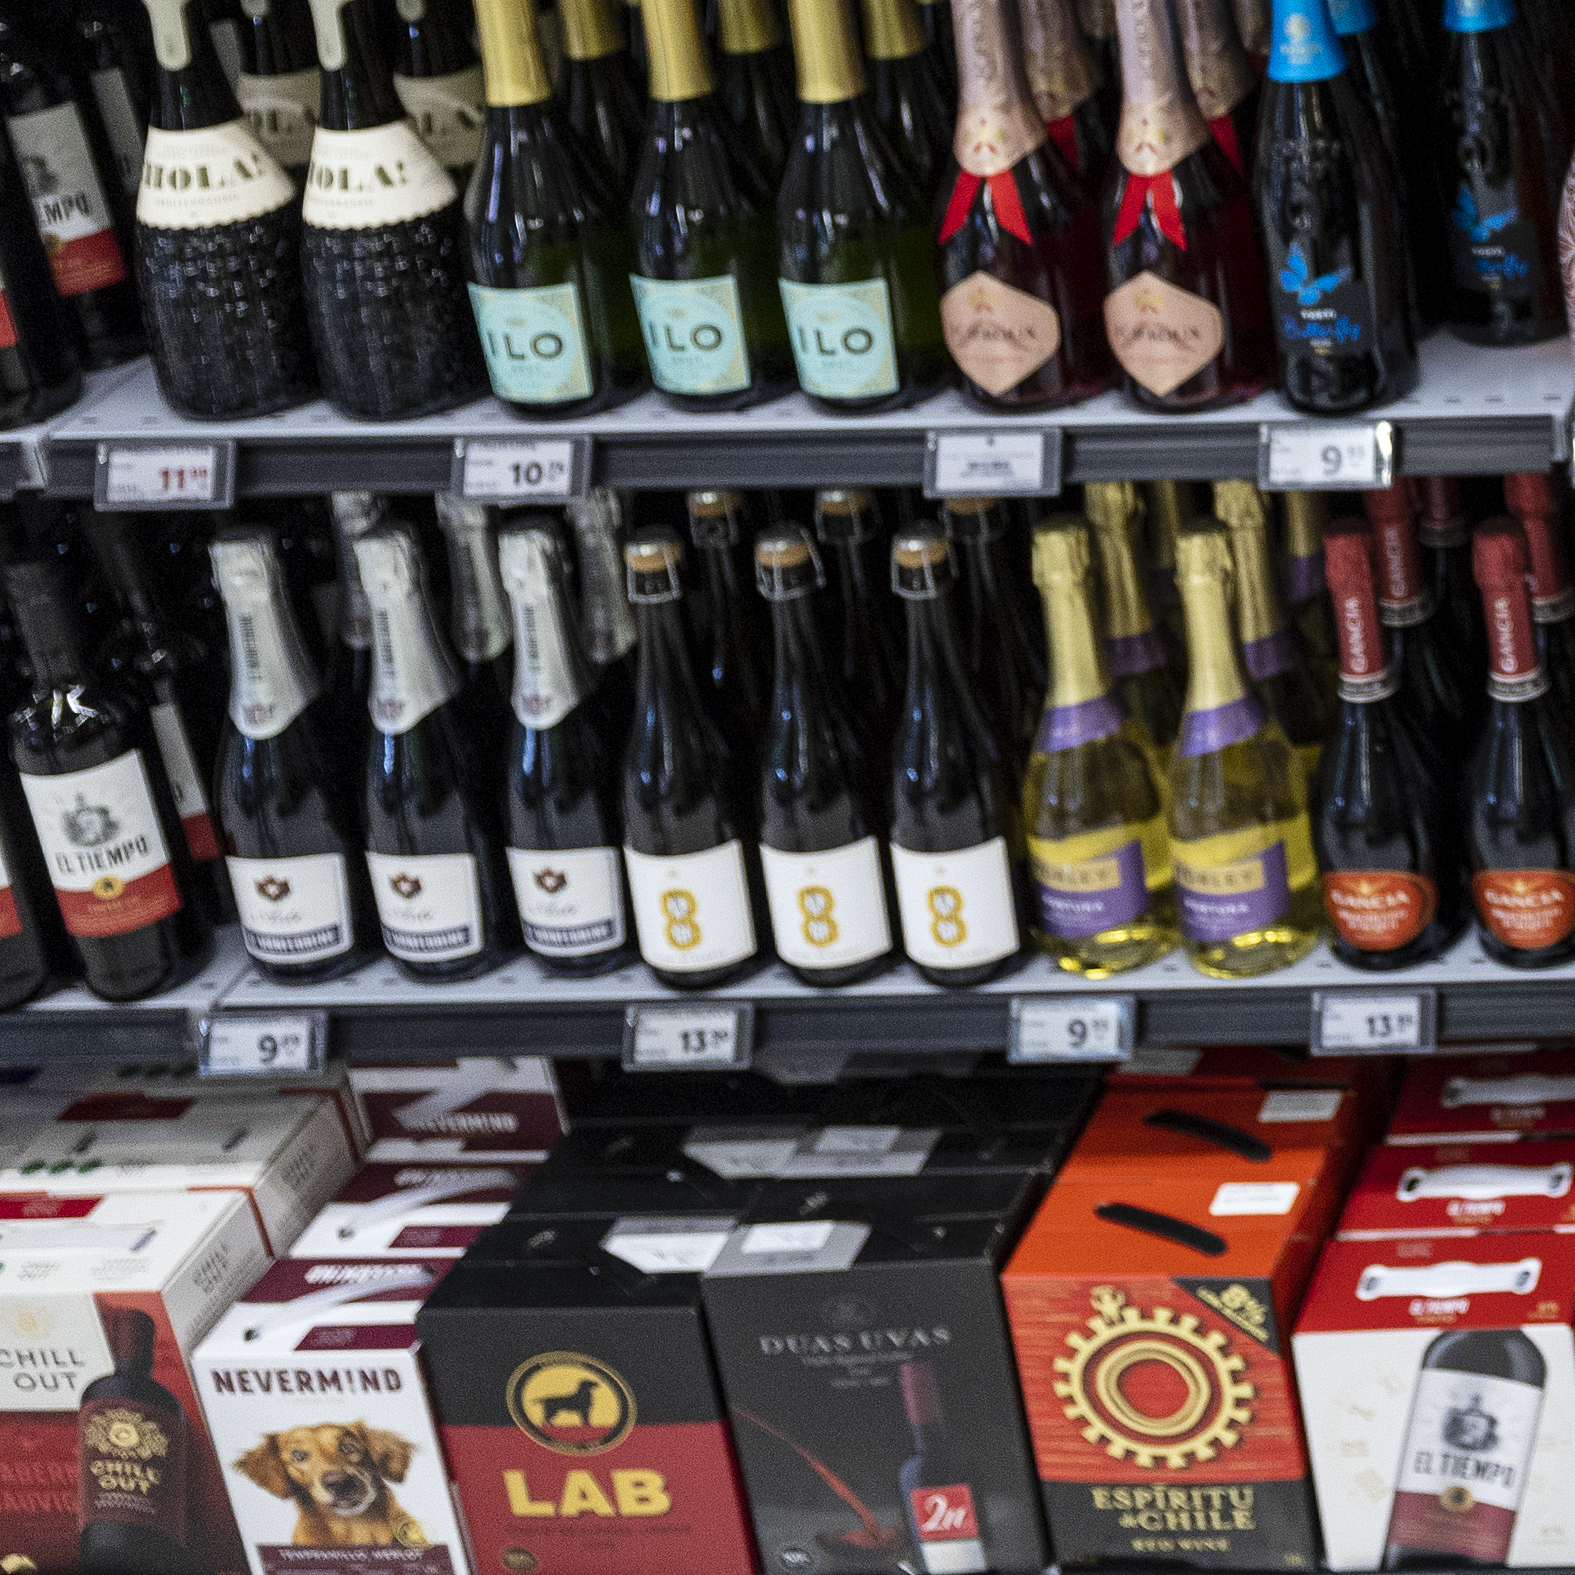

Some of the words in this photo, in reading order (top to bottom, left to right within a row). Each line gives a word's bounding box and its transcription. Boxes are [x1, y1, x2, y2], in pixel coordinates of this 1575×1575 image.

[510, 462, 543, 485] 10
[1321, 446, 1342, 475] 9
[76, 836, 149, 871] TIEMPO
[1067, 1020, 1087, 1047] 9
[258, 1035, 278, 1062] 9
[761, 1333, 852, 1355] DUAS
[860, 1327, 951, 1350] UVAS
[14, 1370, 79, 1392] OUT
[212, 1368, 402, 1395] NEVERMIND
[1415, 1449, 1437, 1474] EL
[1440, 1449, 1515, 1488] TIEMPO
[506, 1469, 671, 1518] LAB
[1136, 1509, 1254, 1531] CHILE
